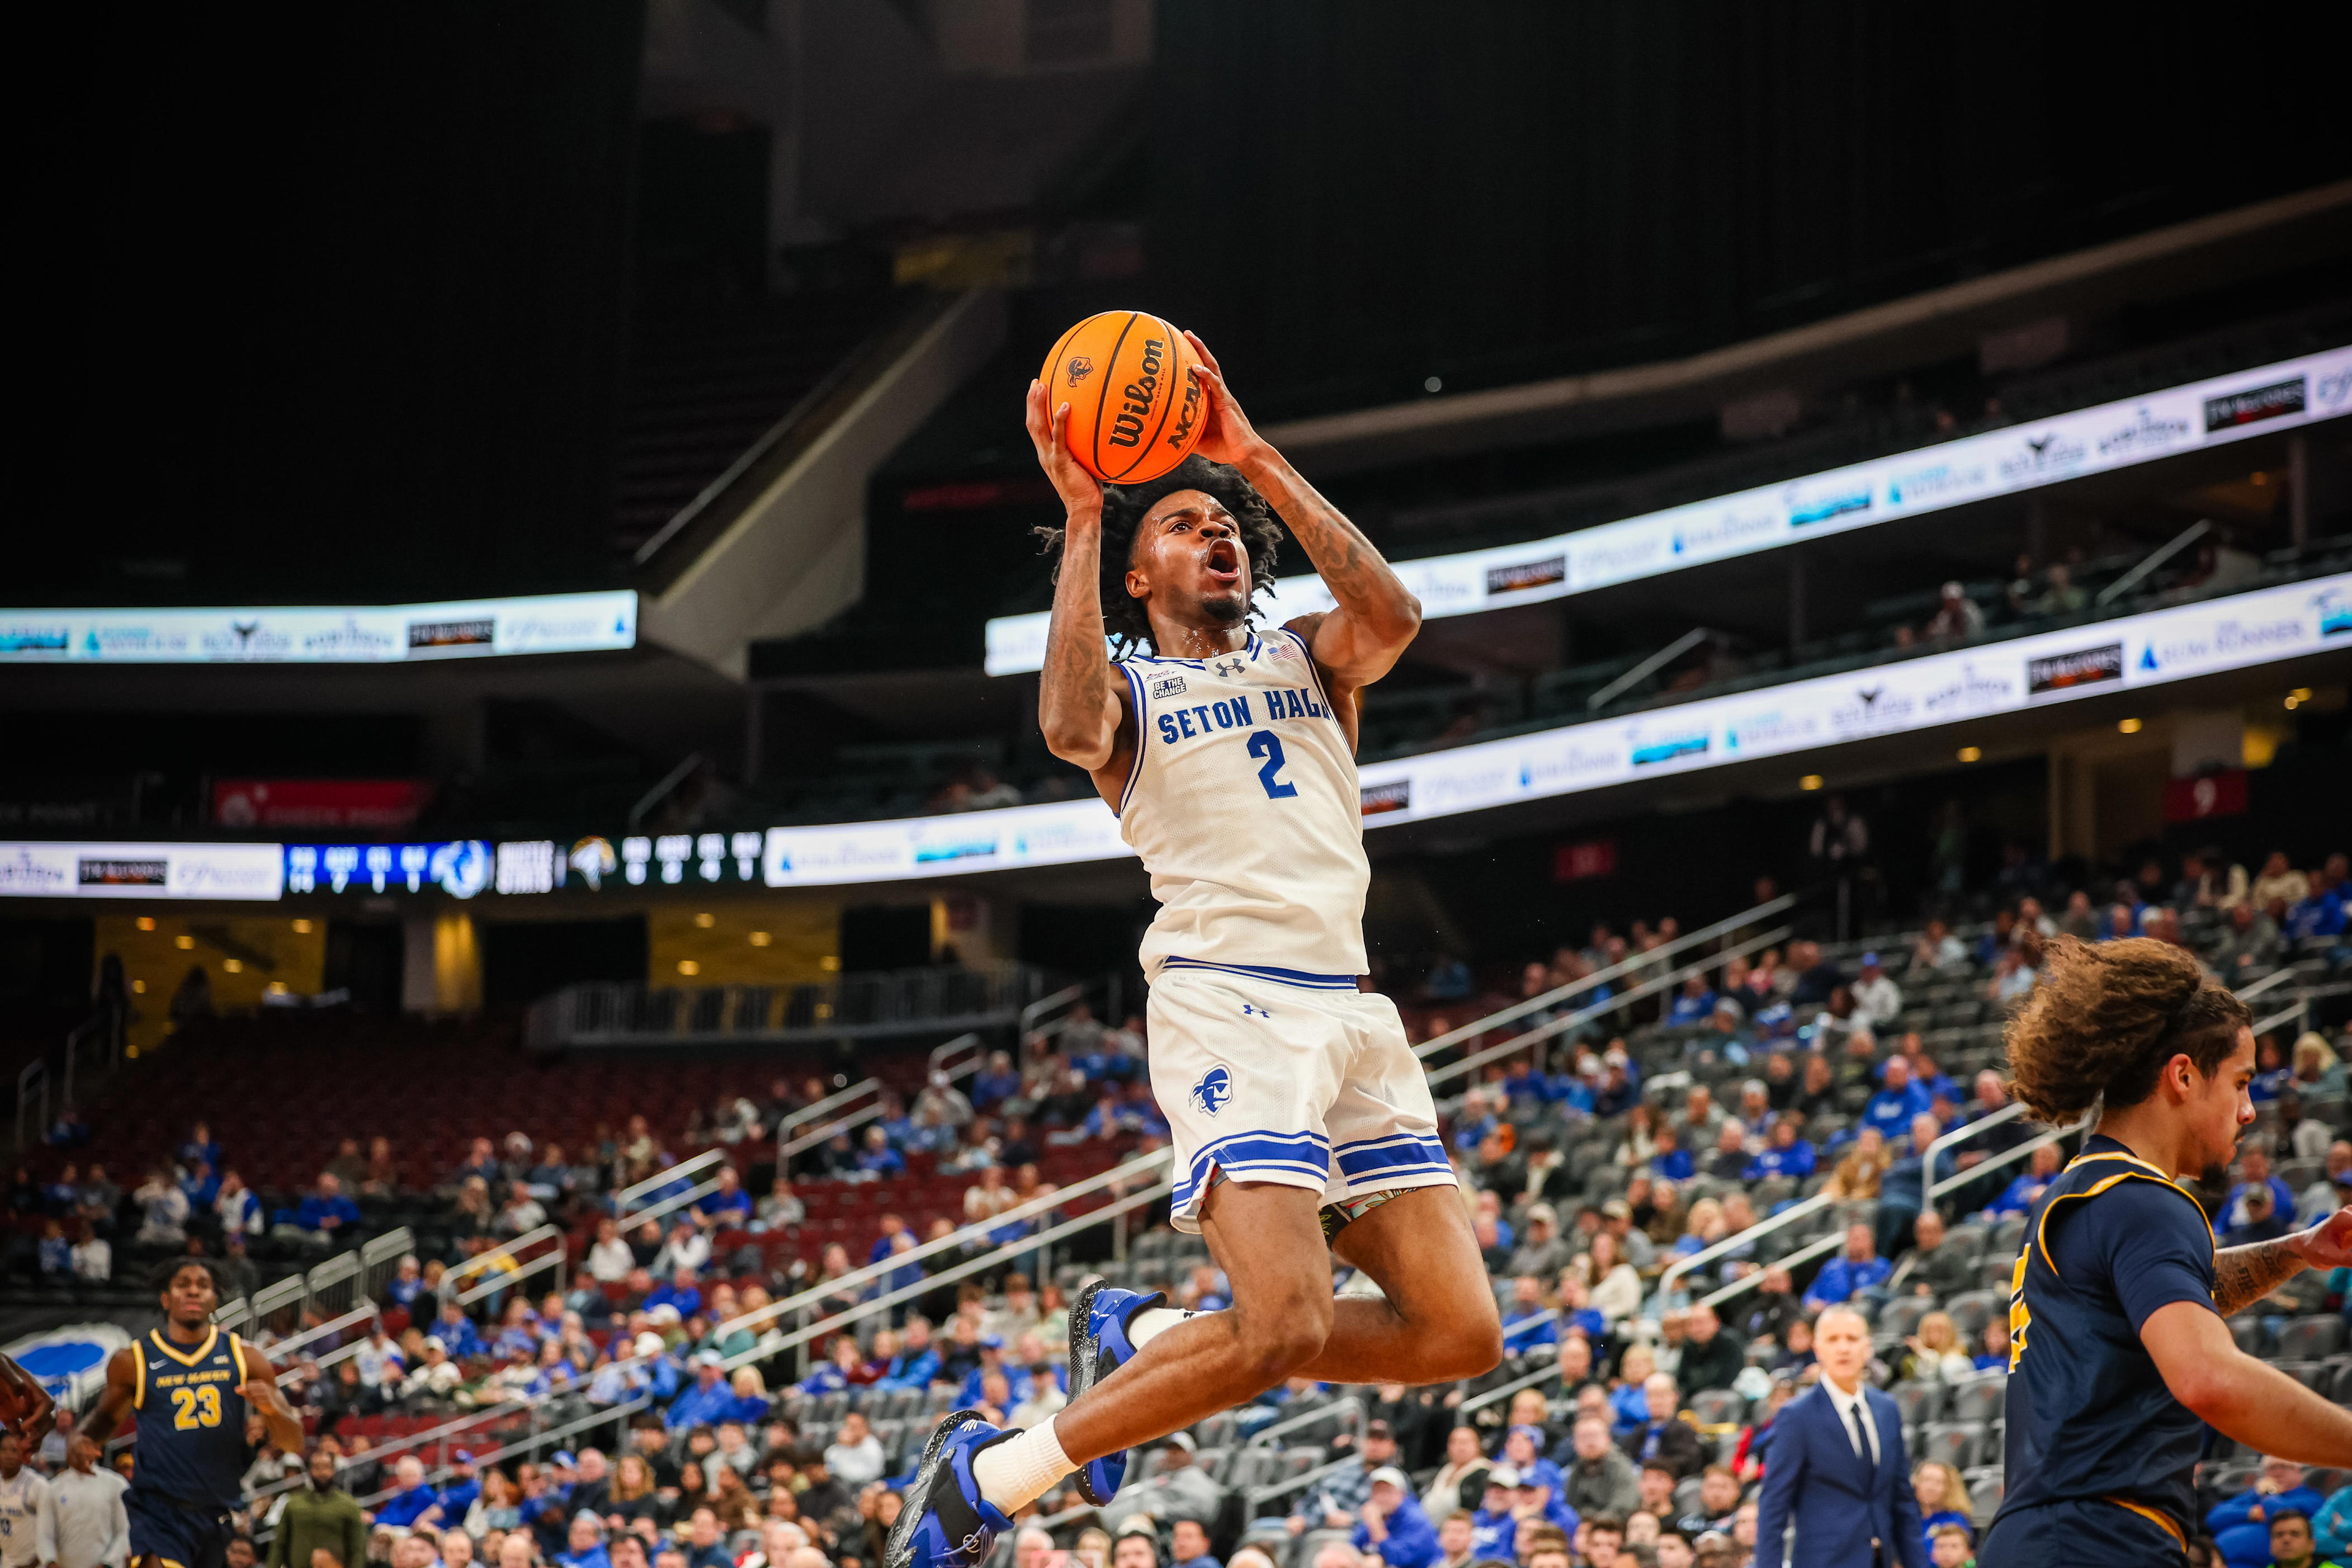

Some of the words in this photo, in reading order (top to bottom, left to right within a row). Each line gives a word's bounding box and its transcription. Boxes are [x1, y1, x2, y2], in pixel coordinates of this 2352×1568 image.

[1108, 339, 1164, 448] Wilson
[1153, 684, 1186, 699] CHANGE
[1154, 681, 1166, 691] BE
[1166, 677, 1183, 688] THE
[1158, 696, 1253, 744] SETON
[1246, 730, 1298, 799] 2
[171, 1383, 222, 1431] 23
